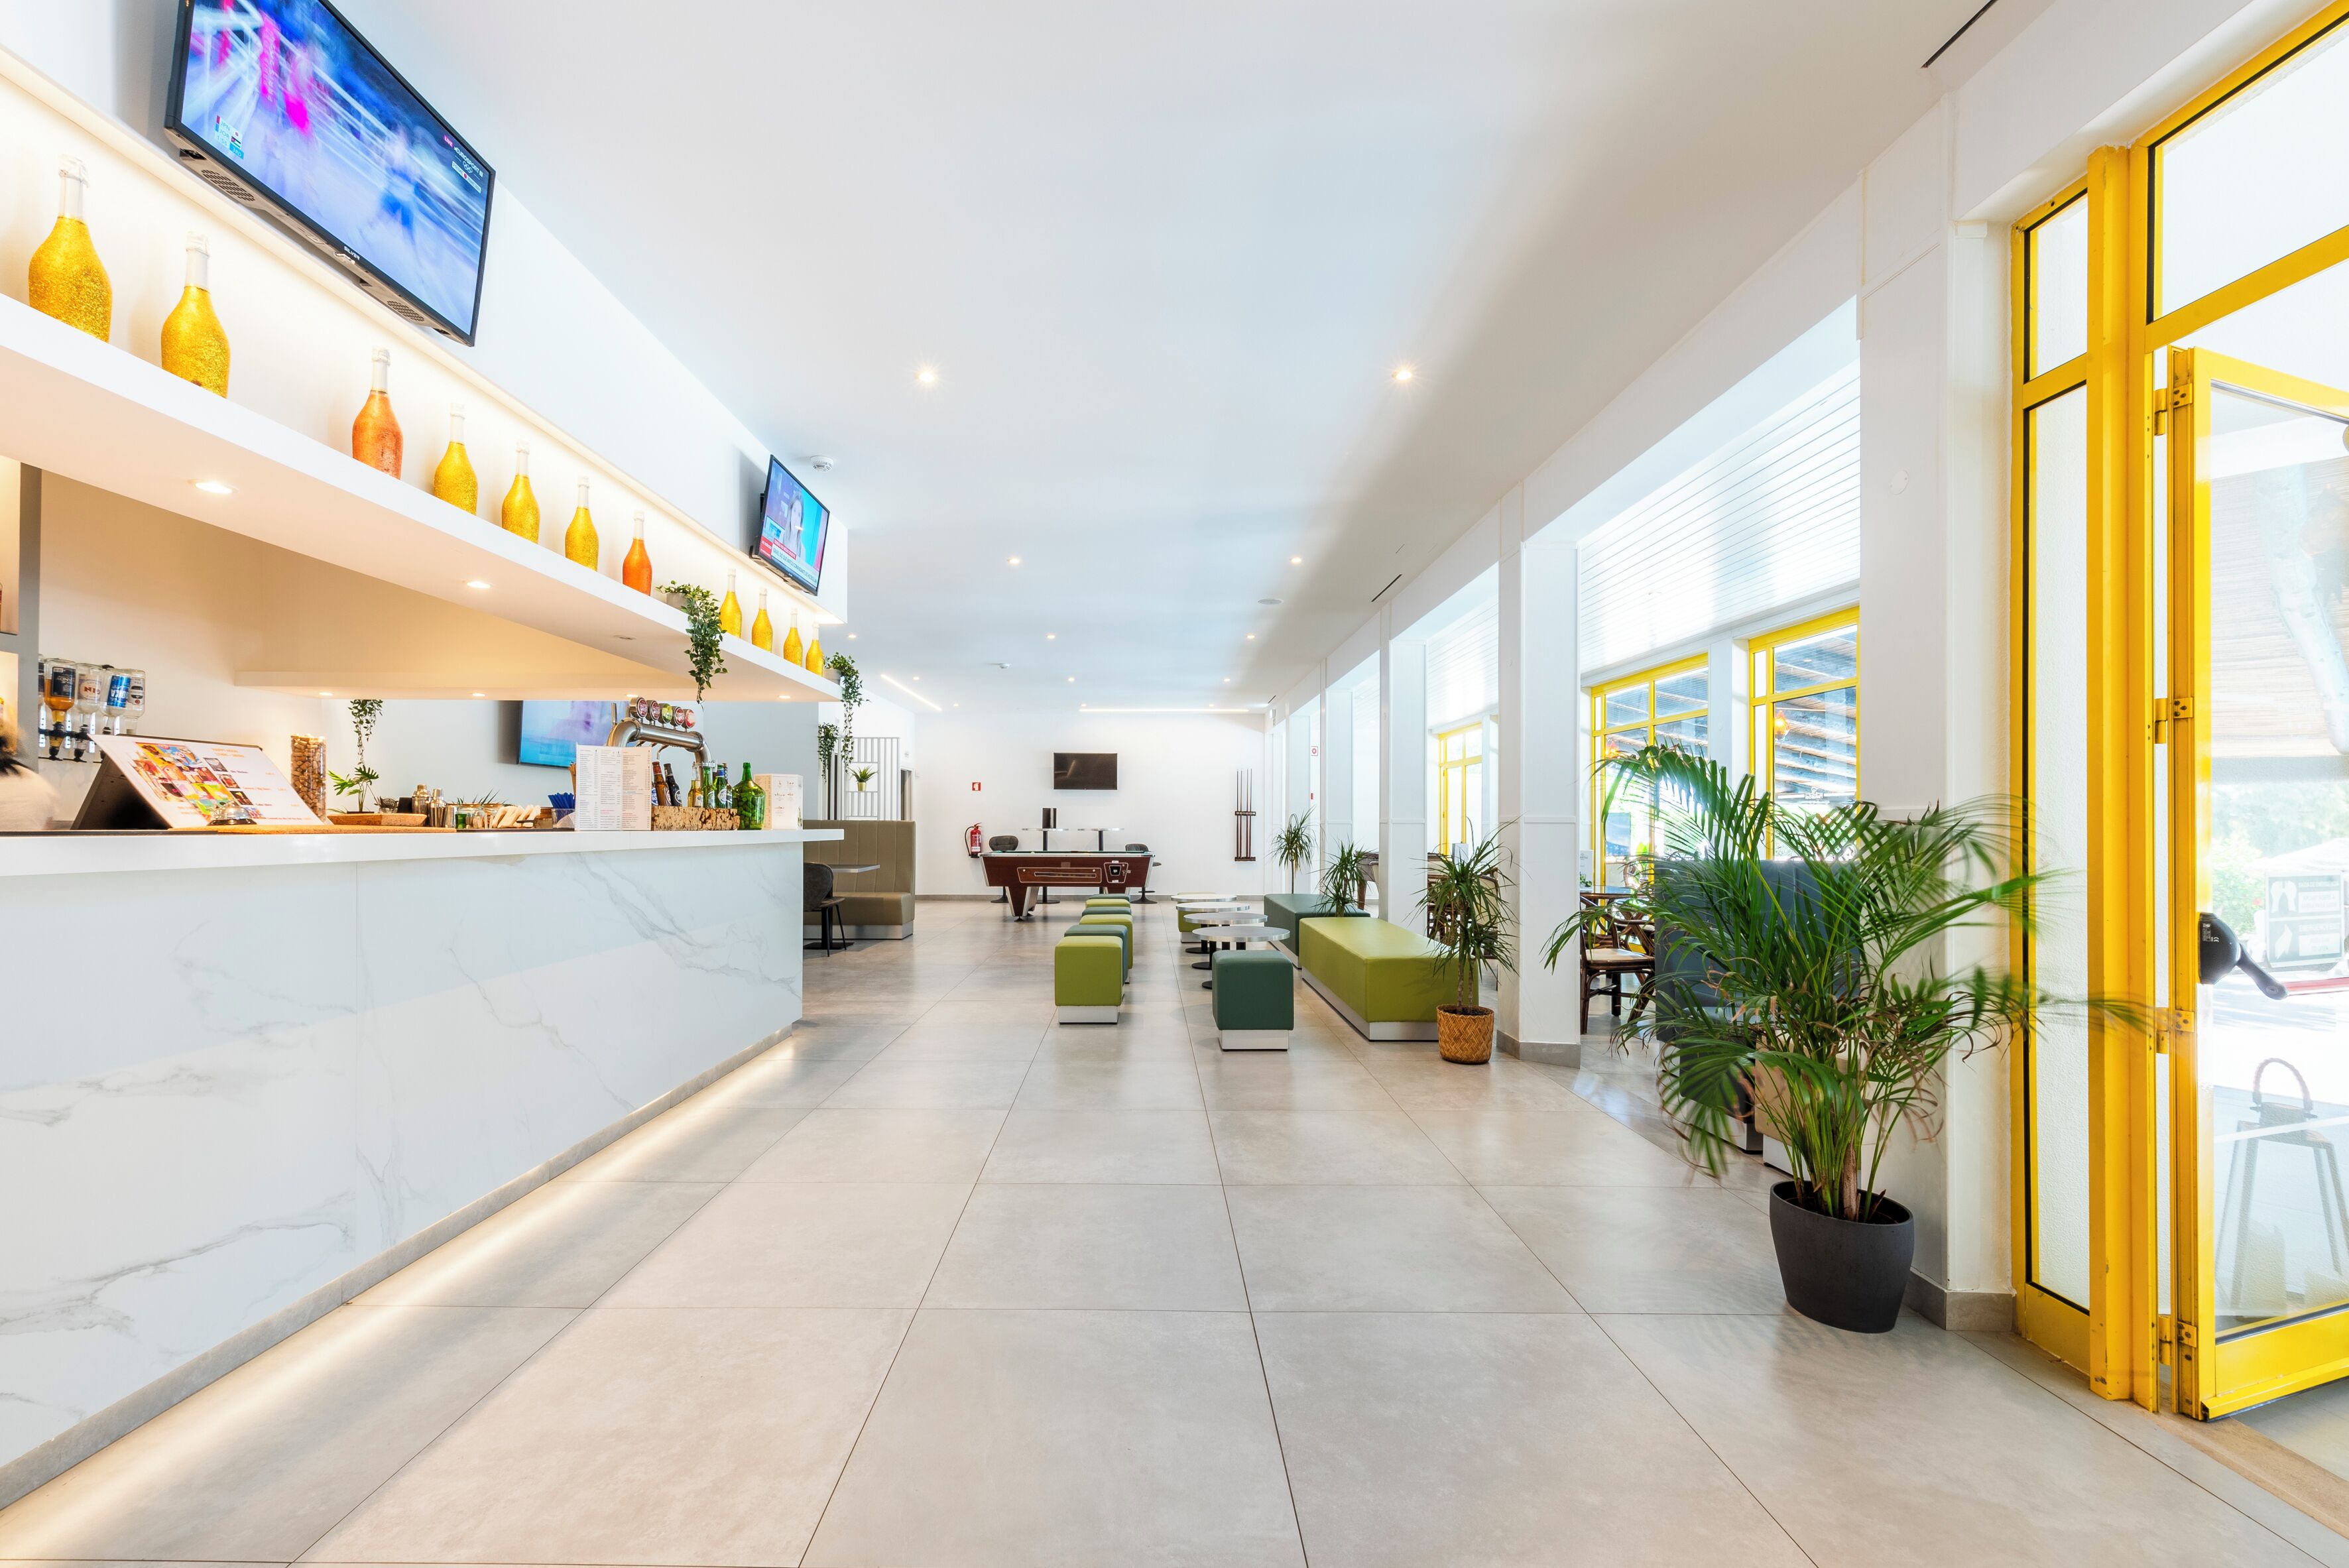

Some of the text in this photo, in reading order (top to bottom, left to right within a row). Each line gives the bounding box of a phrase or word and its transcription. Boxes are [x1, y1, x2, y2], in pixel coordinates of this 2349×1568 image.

[221, 121, 230, 131] JPN
[219, 129, 229, 139] JOR
[444, 136, 453, 147] LIVE
[344, 246, 360, 260] SILVER
